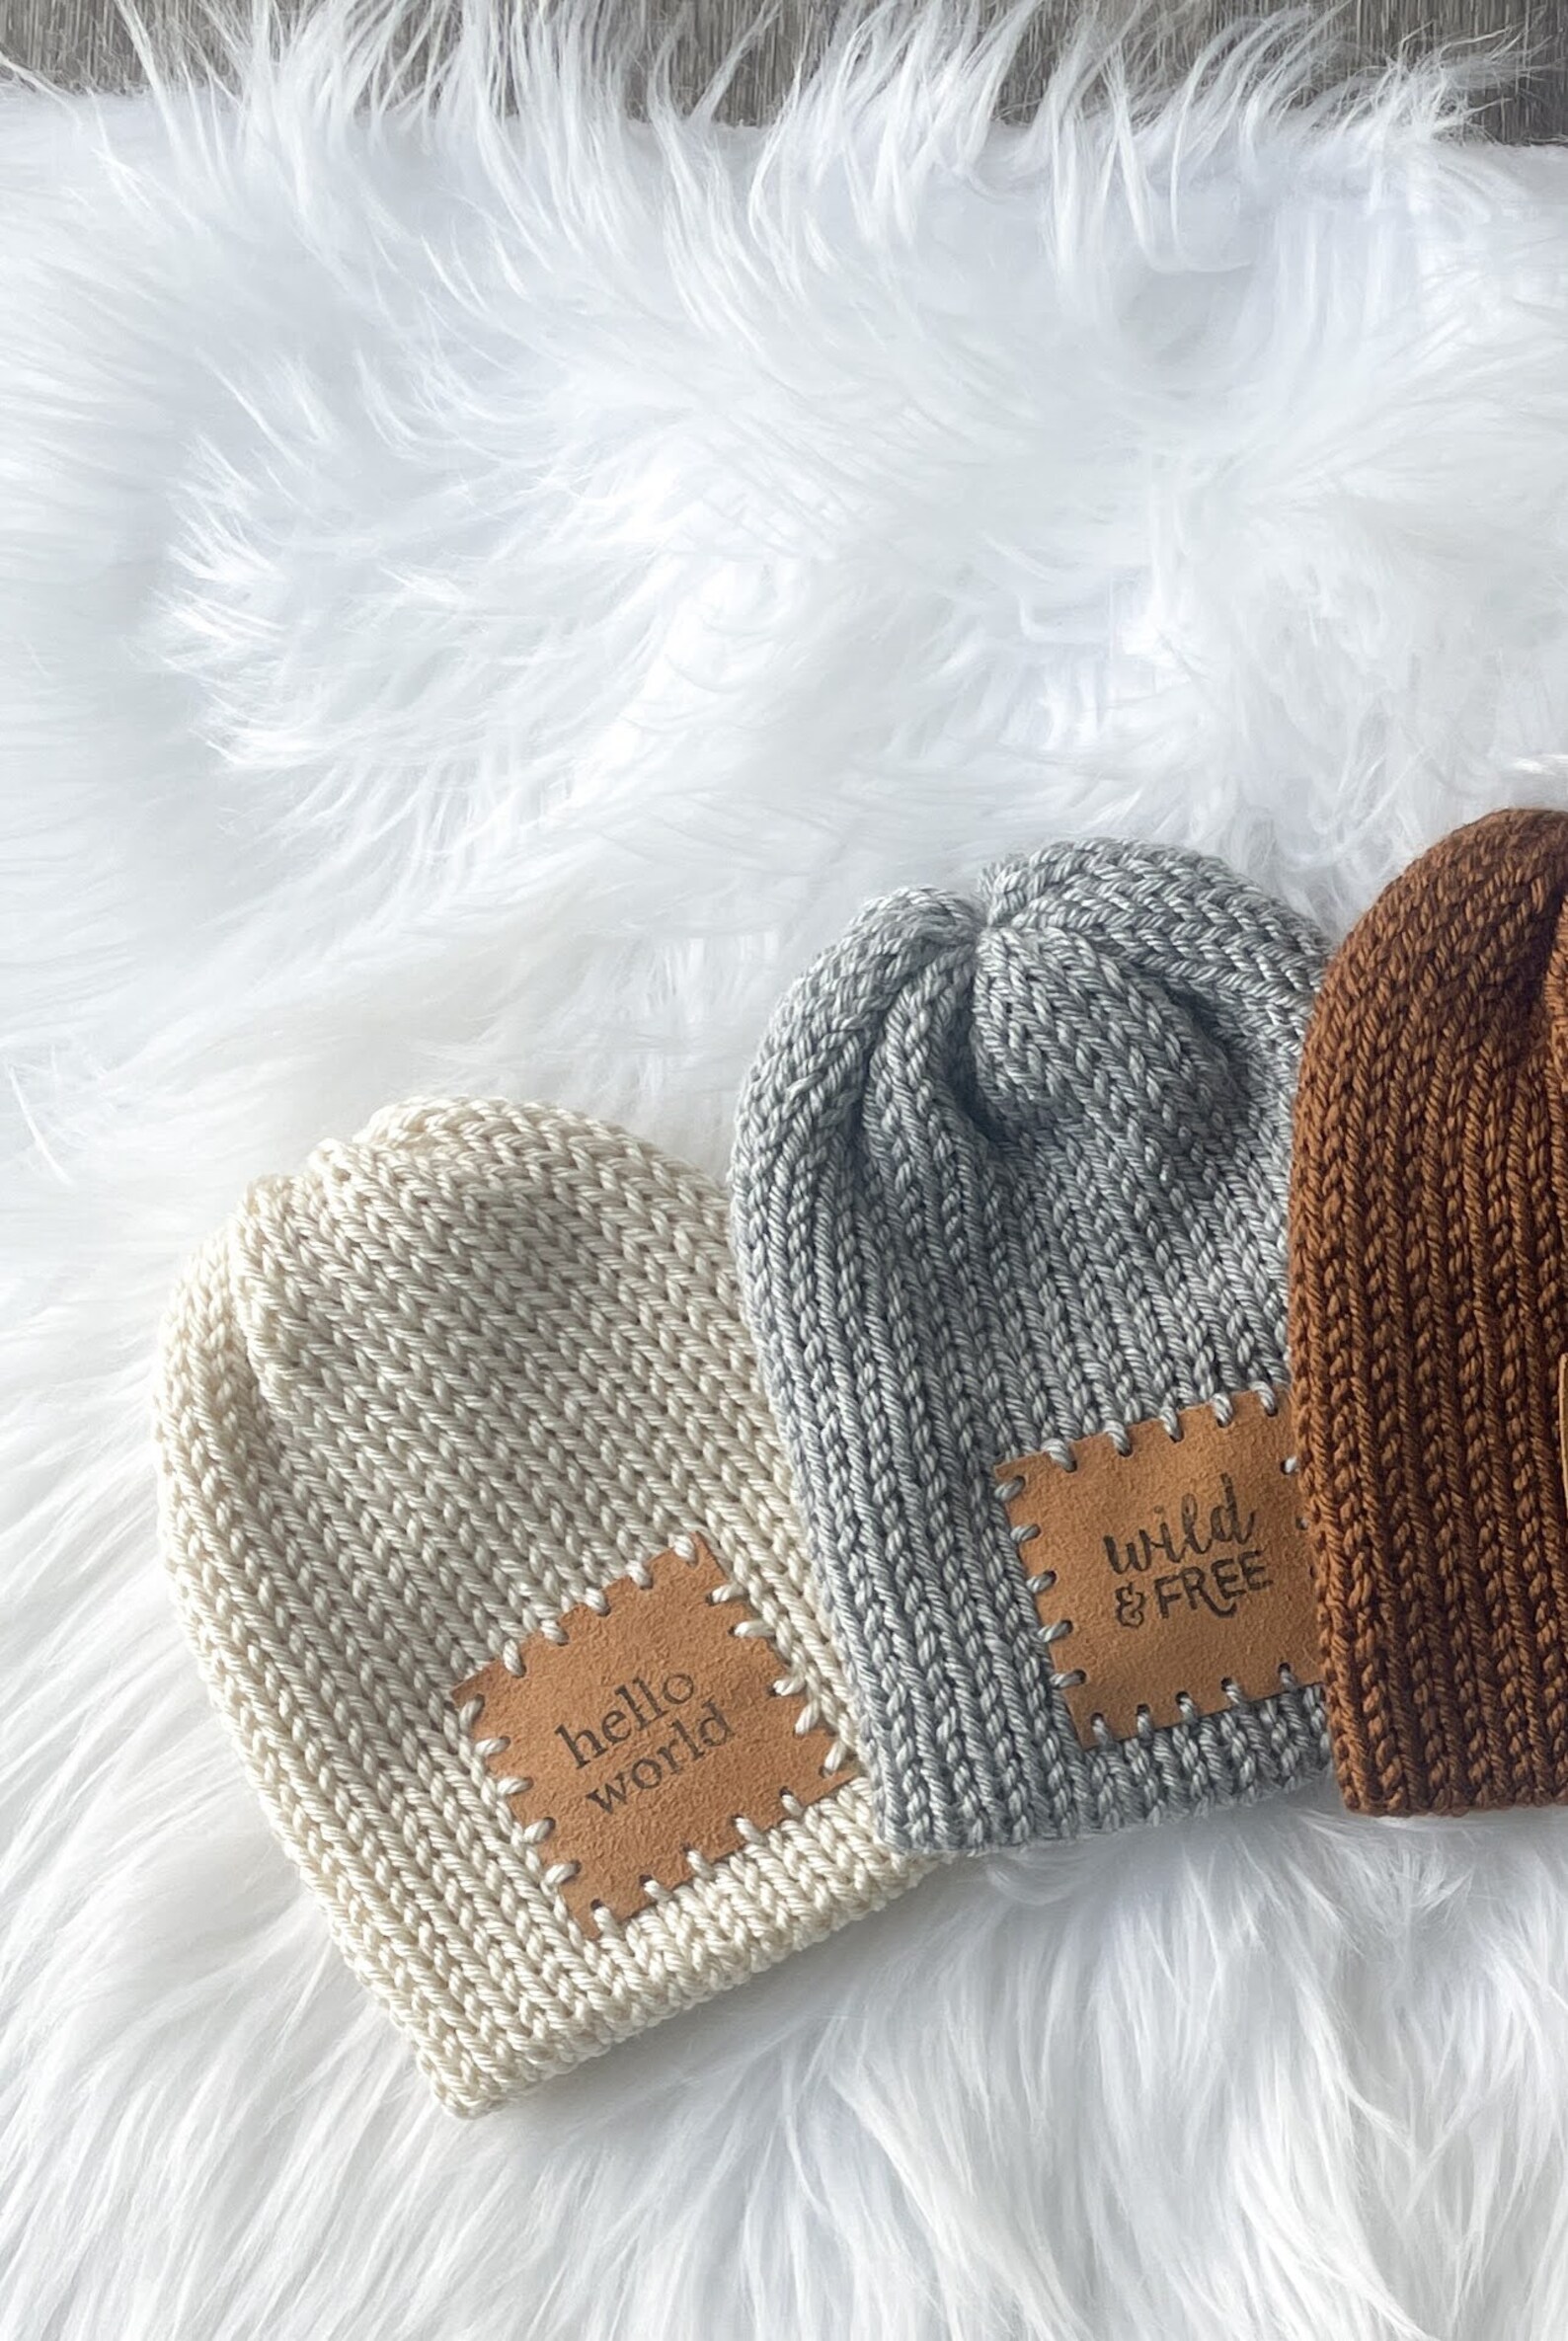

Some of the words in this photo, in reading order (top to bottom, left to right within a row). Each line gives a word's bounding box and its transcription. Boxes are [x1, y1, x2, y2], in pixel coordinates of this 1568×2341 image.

[1103, 1472, 1255, 1574] wild
[1153, 1549, 1274, 1618] FREE
[555, 1672, 695, 1770] hello
[586, 1699, 736, 1815] world
